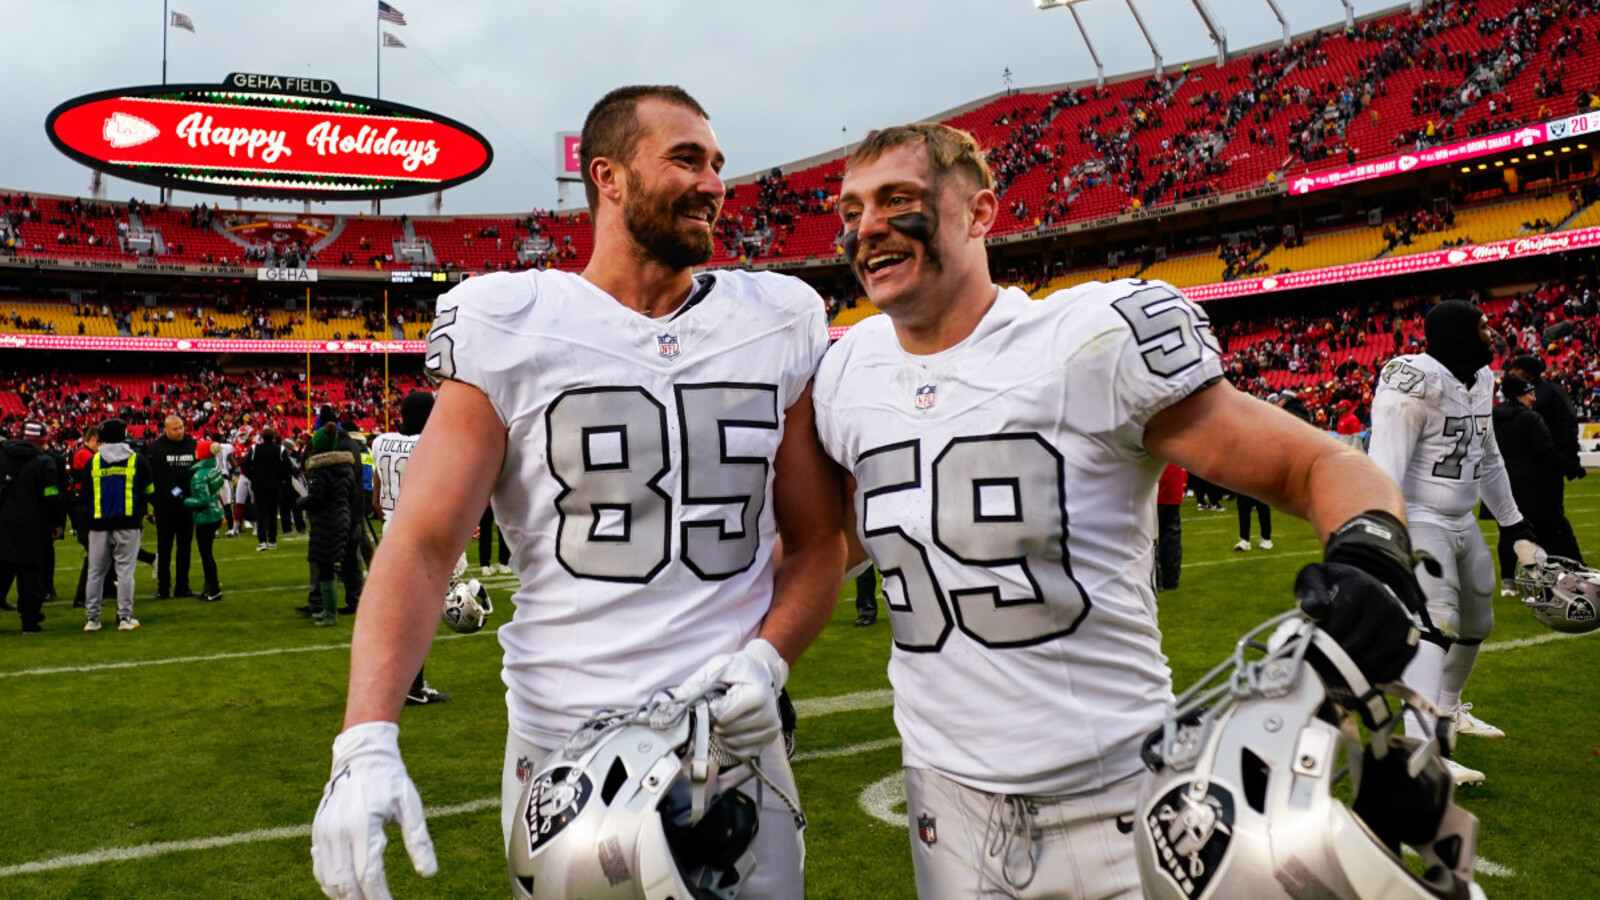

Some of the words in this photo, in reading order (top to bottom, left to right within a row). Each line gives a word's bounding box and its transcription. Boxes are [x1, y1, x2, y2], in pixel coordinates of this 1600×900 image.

[233, 73, 282, 90] GEHA
[286, 77, 332, 94] FIELD
[1571, 116, 1588, 134] 20
[176, 111, 292, 163] Happy
[306, 121, 440, 172] Holidays
[1467, 140, 1487, 153] DRINK
[1487, 135, 1511, 149] SMART
[1472, 245, 1510, 259] Merry
[1515, 236, 1569, 252] Christmas
[266, 268, 309, 280] GEHA
[1110, 286, 1223, 379] 5
[661, 344, 680, 354] NFL
[1382, 360, 1426, 393] 77
[918, 395, 933, 407] NFL
[1432, 413, 1491, 480] 77
[545, 382, 779, 584] 85
[854, 431, 1093, 652] 59
